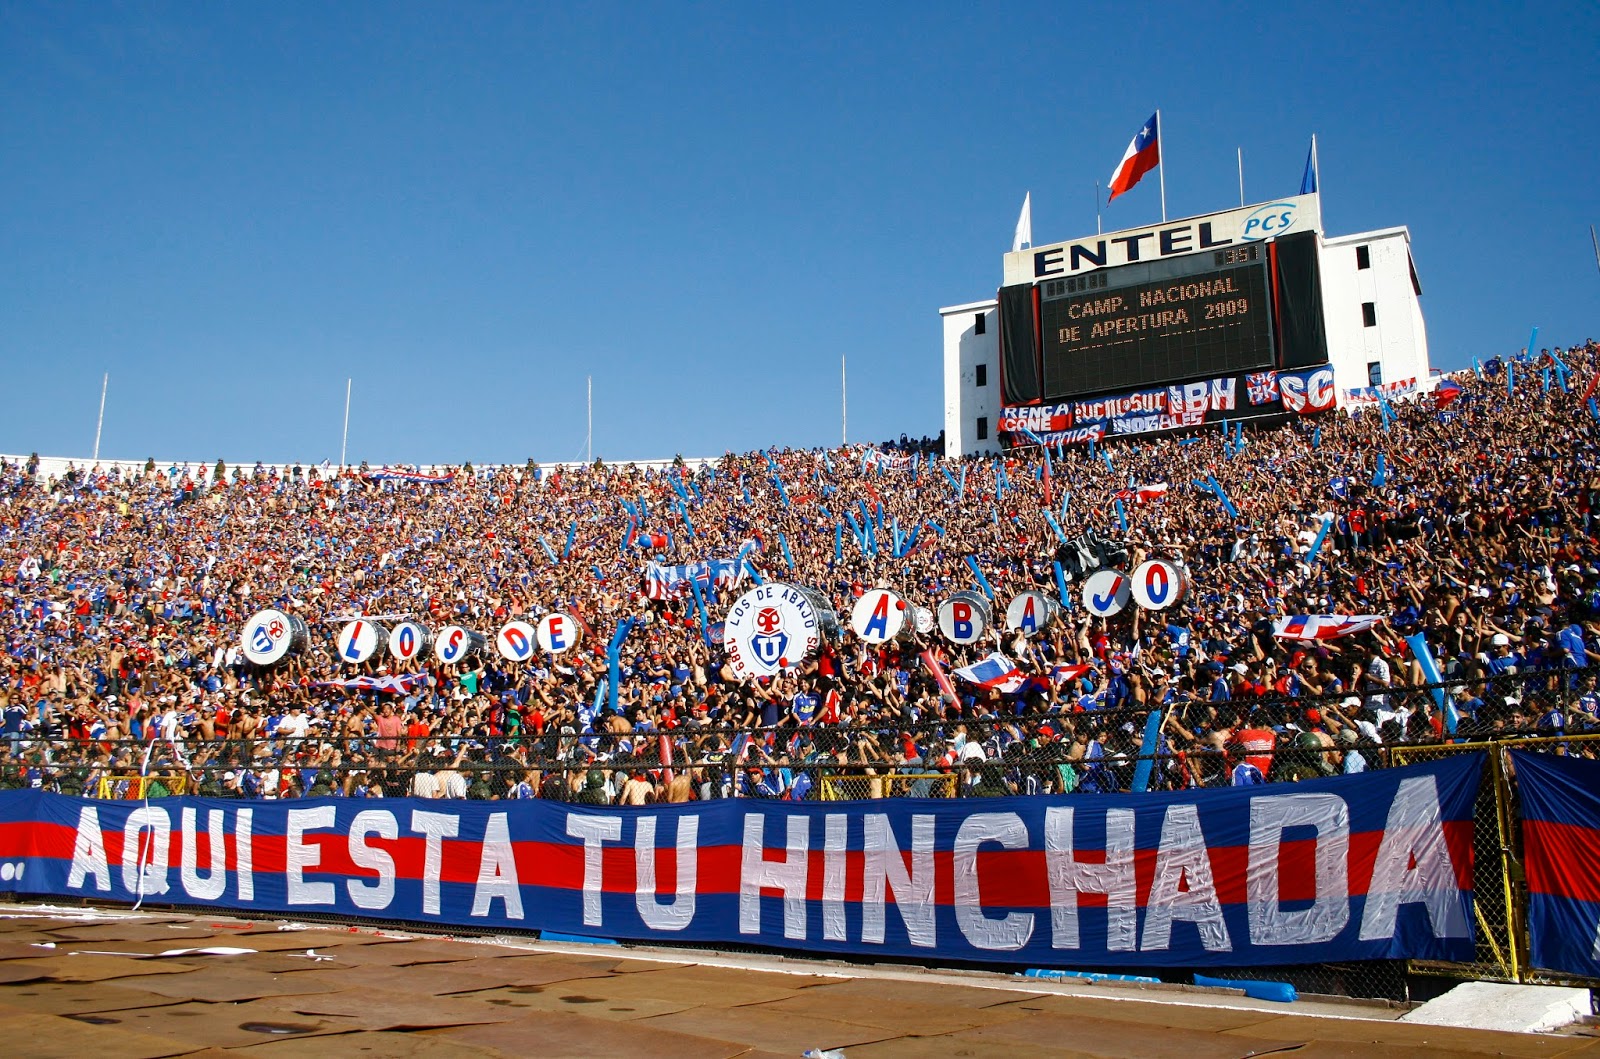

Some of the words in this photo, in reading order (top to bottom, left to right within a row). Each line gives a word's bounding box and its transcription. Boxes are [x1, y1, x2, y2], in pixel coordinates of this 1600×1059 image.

[1034, 221, 1233, 278] ENTEL
[1244, 210, 1291, 235] PCS
[1139, 277, 1239, 307] NACIONAL
[1058, 325, 1081, 344] DE
[1090, 308, 1189, 339] APERTURA
[1204, 298, 1249, 320] 2009
[1004, 402, 1070, 419] RENCA
[730, 599, 751, 627] LOS
[756, 586, 773, 601] DE
[781, 588, 815, 629] ABAJO
[67, 805, 254, 900] AQUI
[286, 805, 525, 921] ESTA
[565, 812, 700, 931] TU
[738, 774, 1471, 952] HINCHADA
